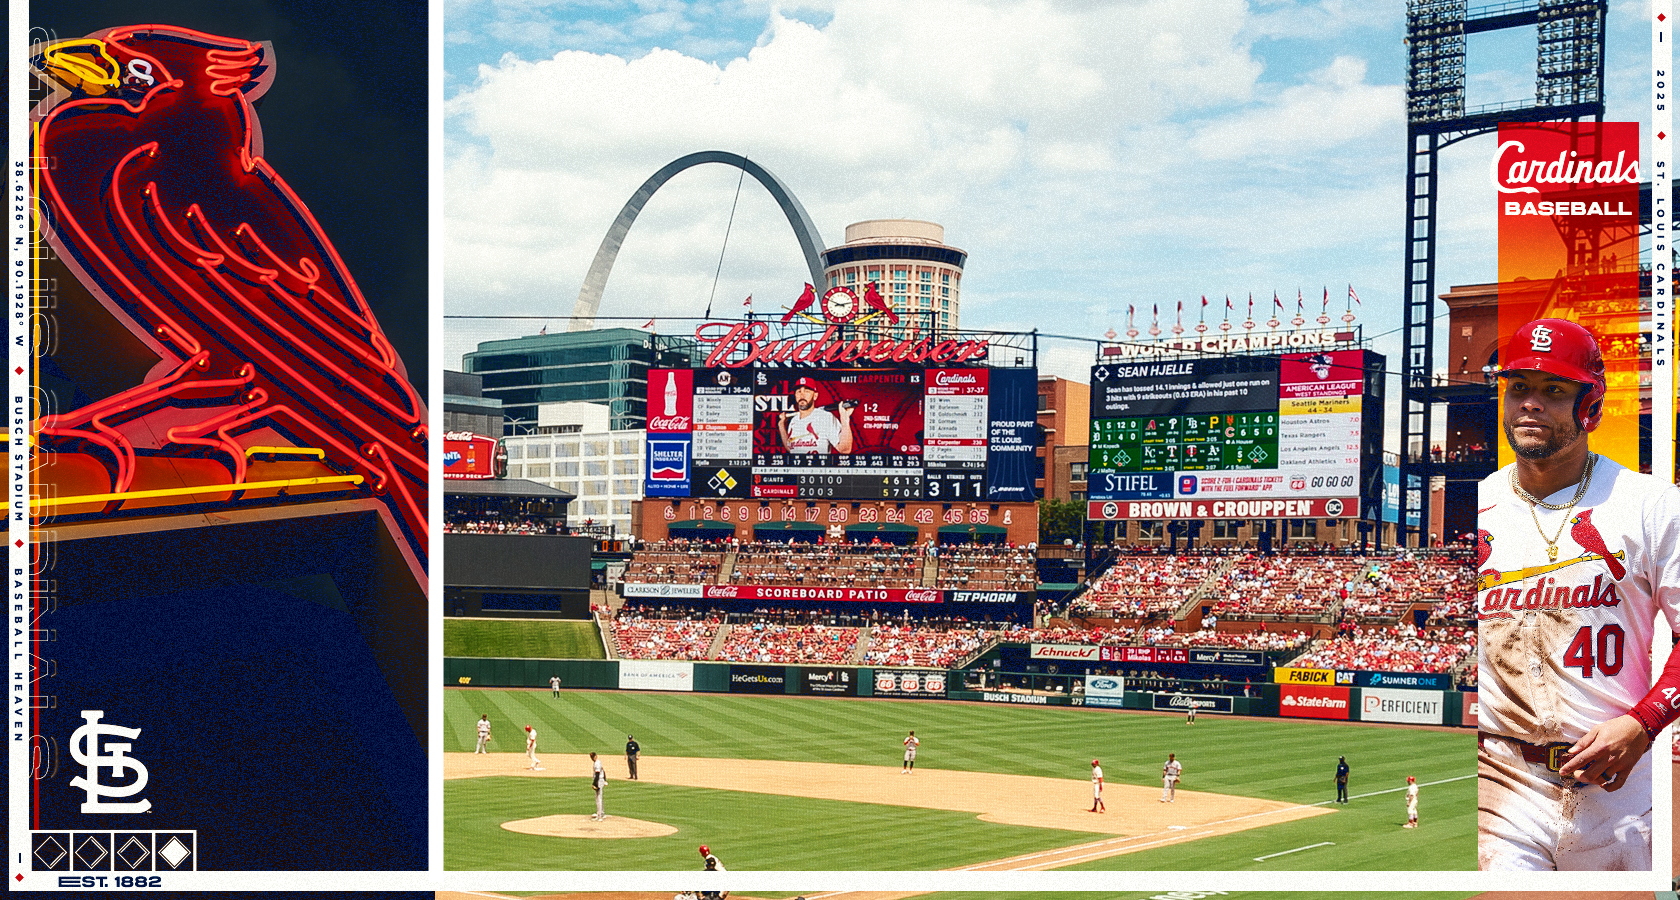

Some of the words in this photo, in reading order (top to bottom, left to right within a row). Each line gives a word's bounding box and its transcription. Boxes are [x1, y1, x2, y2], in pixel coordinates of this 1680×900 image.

[696, 322, 988, 369] Budweiser
[1120, 341, 1196, 358] WORLD
[1201, 332, 1336, 353] CHAMPIONS
[1117, 366, 1148, 378] SEAN
[1150, 363, 1194, 376] HJELLE
[858, 375, 905, 383] CARPENTER
[936, 371, 976, 385] Cardinals
[1169, 383, 1191, 391] innings
[1198, 381, 1222, 389] allowed
[1223, 381, 1235, 389] just
[1286, 384, 1325, 392] AMERICAN
[1326, 382, 1356, 390] LEAGUE
[1224, 389, 1238, 397] past
[755, 395, 795, 412] STL
[864, 404, 878, 412] 1-2
[1106, 402, 1130, 410] outings.
[650, 416, 690, 430] Coca-Cola
[1105, 474, 1158, 491] STIFEL
[1311, 476, 1323, 488] GO
[1326, 476, 1338, 487] GO
[1341, 476, 1353, 487] GO
[928, 482, 939, 496] 3
[952, 482, 960, 497] 1
[973, 482, 980, 497] 1
[1129, 502, 1192, 517] BROWN
[1197, 505, 1208, 517] &
[1213, 500, 1310, 517] CROUPPEN
[690, 506, 696, 520] 1
[703, 506, 713, 520] 2
[721, 506, 730, 520] 6
[739, 506, 748, 521] 9
[758, 507, 772, 521] 10
[781, 507, 796, 521] 14
[805, 507, 820, 522] 17
[828, 508, 847, 522] 20
[859, 508, 878, 523] 23
[886, 508, 905, 523] 24
[914, 508, 933, 524] 42
[943, 509, 963, 524] 45
[969, 509, 989, 524] 85
[707, 586, 739, 598] Coca-Cola
[756, 588, 843, 599] SCOREBOARD
[849, 590, 888, 600] PATIO
[905, 590, 938, 602] Coca-Cola
[1035, 646, 1096, 658] Schnucks
[1563, 624, 1625, 678] 40
[732, 674, 783, 684] HeGetsUs.com
[808, 673, 828, 682] Mercy
[1289, 671, 1330, 682] FABICK
[1336, 672, 1355, 684] CAT
[1382, 675, 1437, 686] SUMNERONE
[1095, 680, 1113, 689] Ford
[984, 693, 1009, 703] BUSCH
[1011, 693, 1047, 704] STADIUM
[1364, 695, 1437, 714] PERFICIENT
